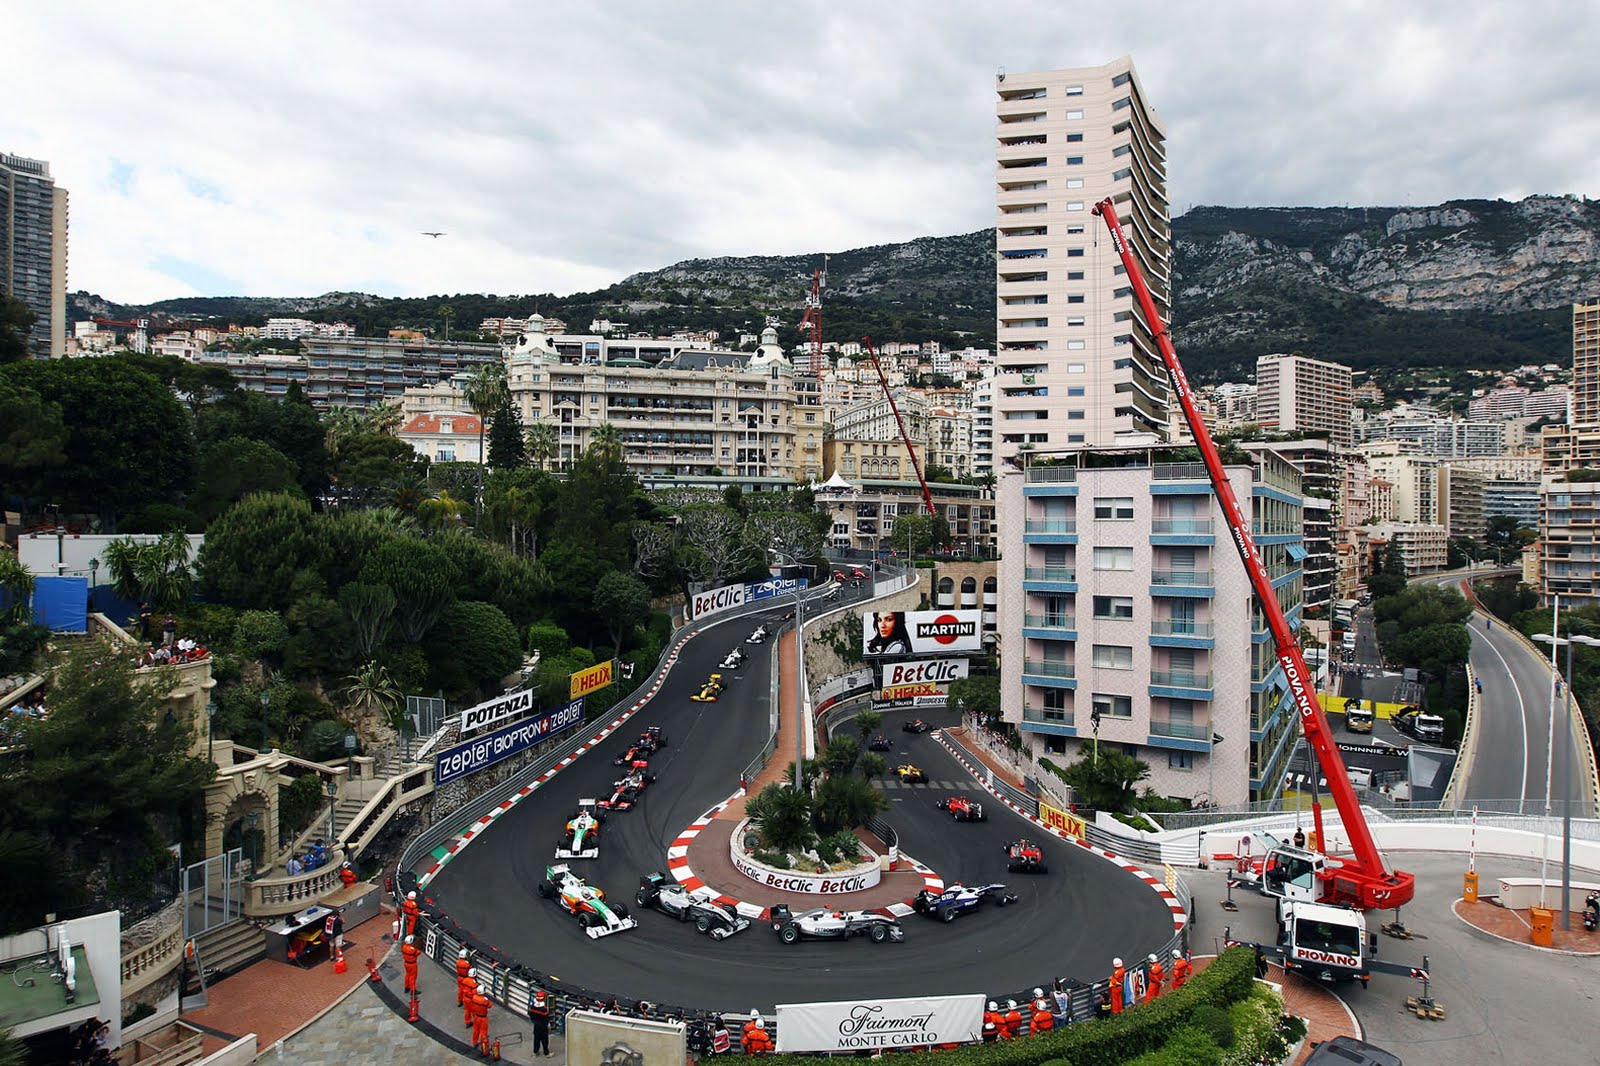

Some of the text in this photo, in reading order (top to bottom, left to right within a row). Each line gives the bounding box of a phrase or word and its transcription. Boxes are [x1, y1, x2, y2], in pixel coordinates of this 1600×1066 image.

[1170, 368, 1185, 397] PIOVANO
[1234, 527, 1250, 559] PIOVANO
[695, 586, 741, 616] BetClic
[920, 624, 973, 636] MARTINI
[580, 666, 611, 692] HELIX
[892, 660, 959, 684] BetClic
[894, 685, 934, 698] HELIX
[1282, 656, 1313, 717] PIOVANO
[466, 694, 529, 728] POTENZA
[551, 702, 583, 728] zepter
[441, 720, 541, 775] zepter BIOPTRON
[1048, 809, 1082, 838] HELIX
[736, 859, 761, 881] BetClic
[766, 874, 813, 892] BetClic
[819, 876, 866, 893] BetClic
[1297, 949, 1358, 967] PIOVANO
[839, 1005, 936, 1036] Fairmont
[837, 1032, 938, 1048] MONTE CARLO
